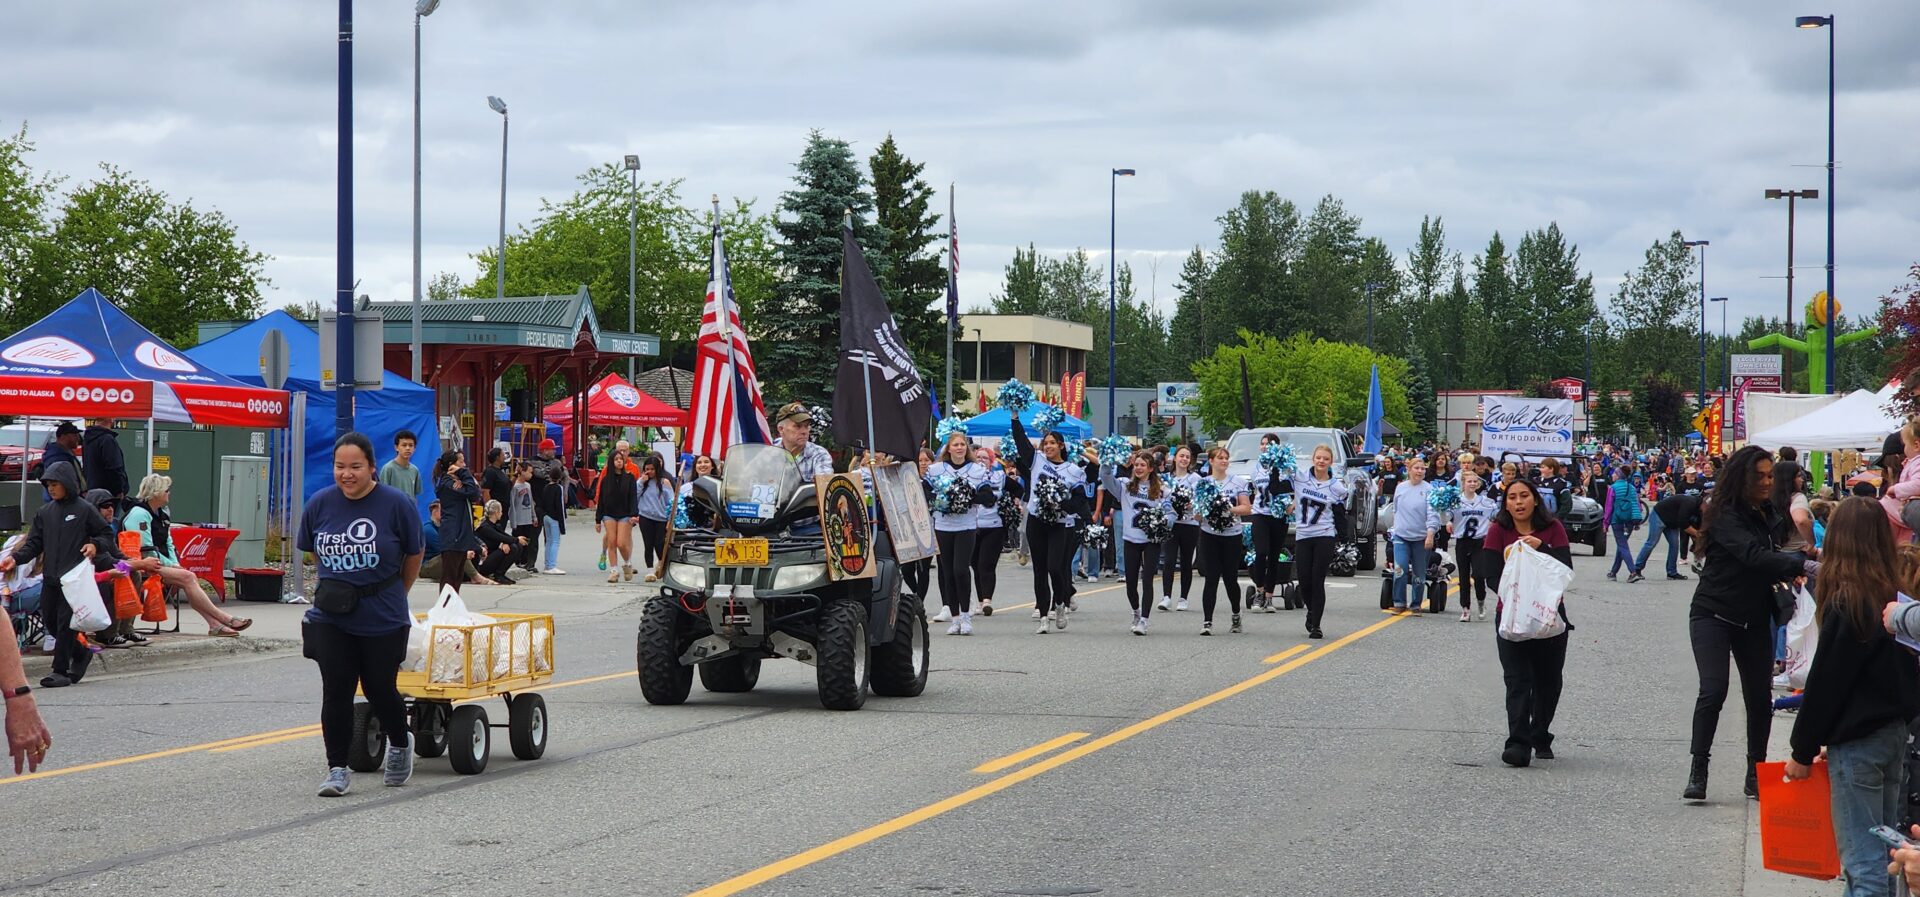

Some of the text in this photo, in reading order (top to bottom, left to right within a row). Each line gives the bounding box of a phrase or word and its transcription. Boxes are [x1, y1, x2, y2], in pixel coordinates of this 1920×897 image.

[526, 331, 565, 348] PEOPLE MOVER
[612, 339, 649, 355] TRANSIT CENTER
[873, 328, 887, 345] YOU
[881, 343, 896, 361] ARE
[893, 356, 911, 373] NOT
[19, 388, 29, 396] TO
[29, 389, 56, 398] ALASKA
[1075, 376, 1083, 402] RINDS
[1484, 405, 1573, 434] Eagle River
[1491, 433, 1562, 443] ORTHODONTICS
[1712, 414, 1720, 454] PIZZ
[752, 485, 777, 504] 28
[1302, 487, 1328, 501] CHUGIAK
[1300, 496, 1326, 525] 17
[1463, 516, 1479, 539] 6
[316, 531, 347, 546] First
[316, 540, 377, 556] National
[718, 545, 762, 559] 7 135
[319, 553, 380, 571] PROUD
